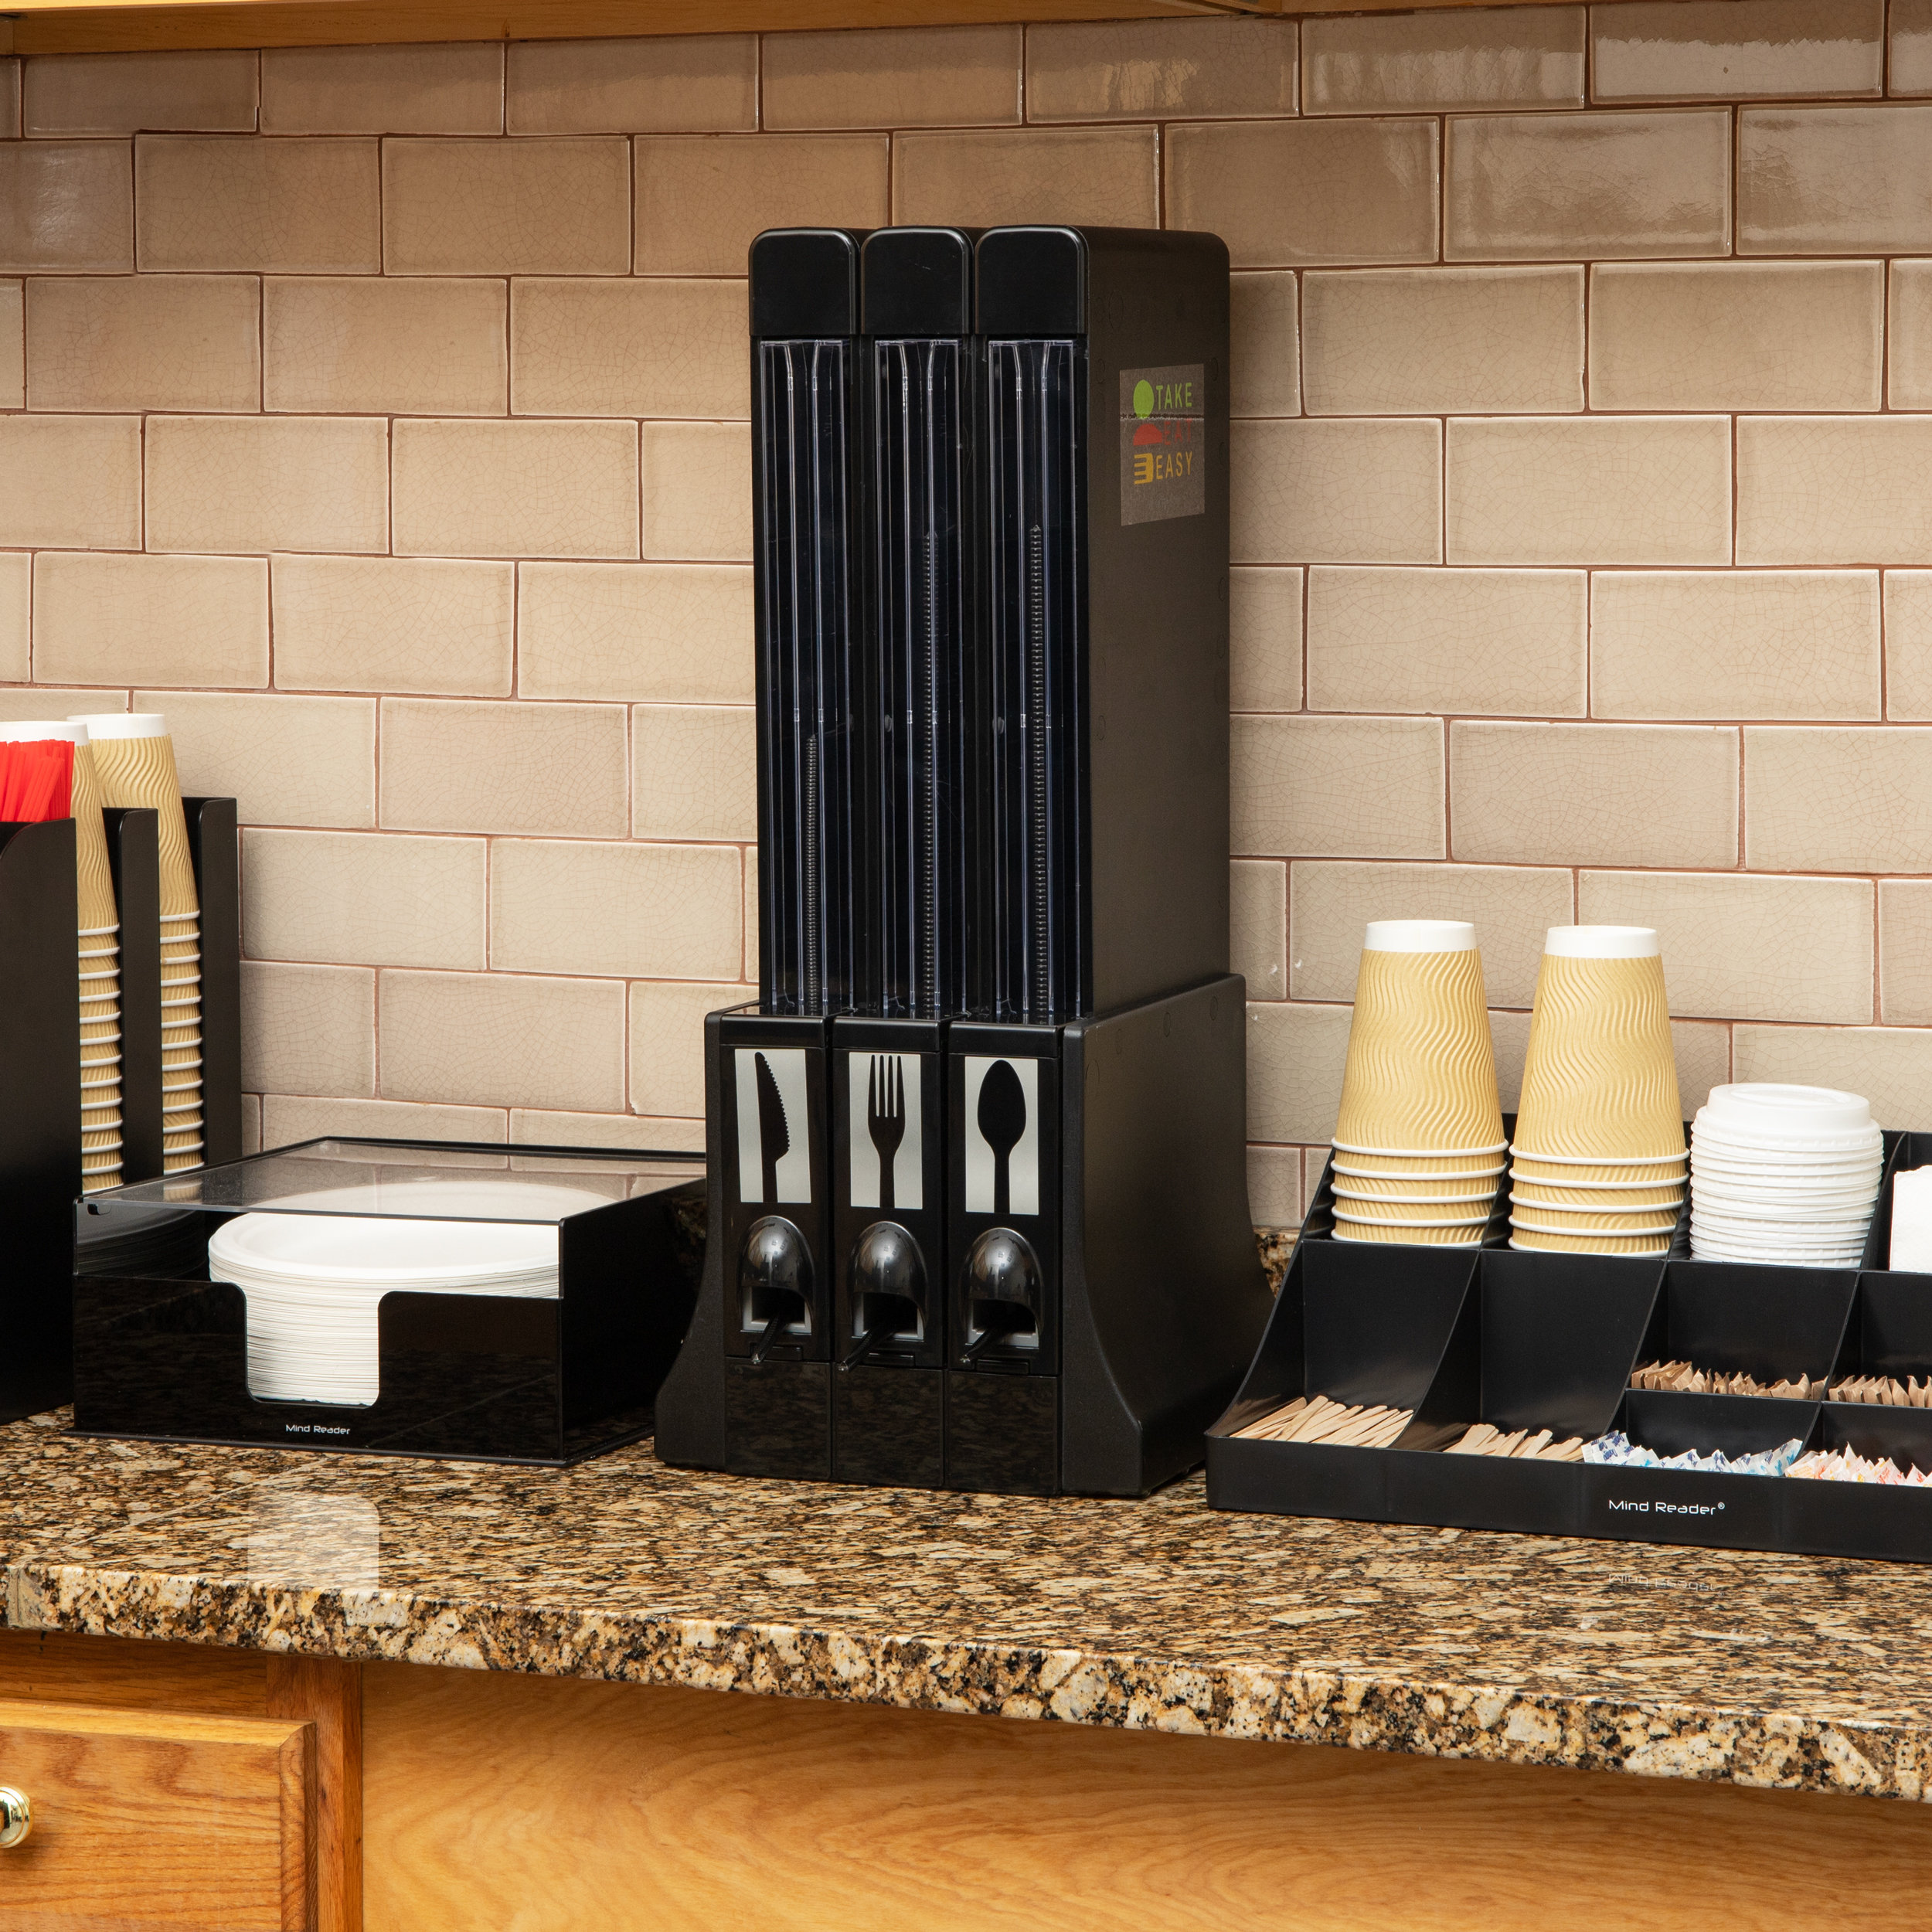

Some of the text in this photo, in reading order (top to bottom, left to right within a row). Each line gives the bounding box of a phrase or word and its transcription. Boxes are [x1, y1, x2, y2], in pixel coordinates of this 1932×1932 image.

[1155, 383, 1192, 410] TAKE
[1163, 418, 1193, 445] EAT
[1155, 451, 1193, 480] EASY
[285, 1424, 351, 1435] Mind Reader
[1608, 1499, 1649, 1512] Mind
